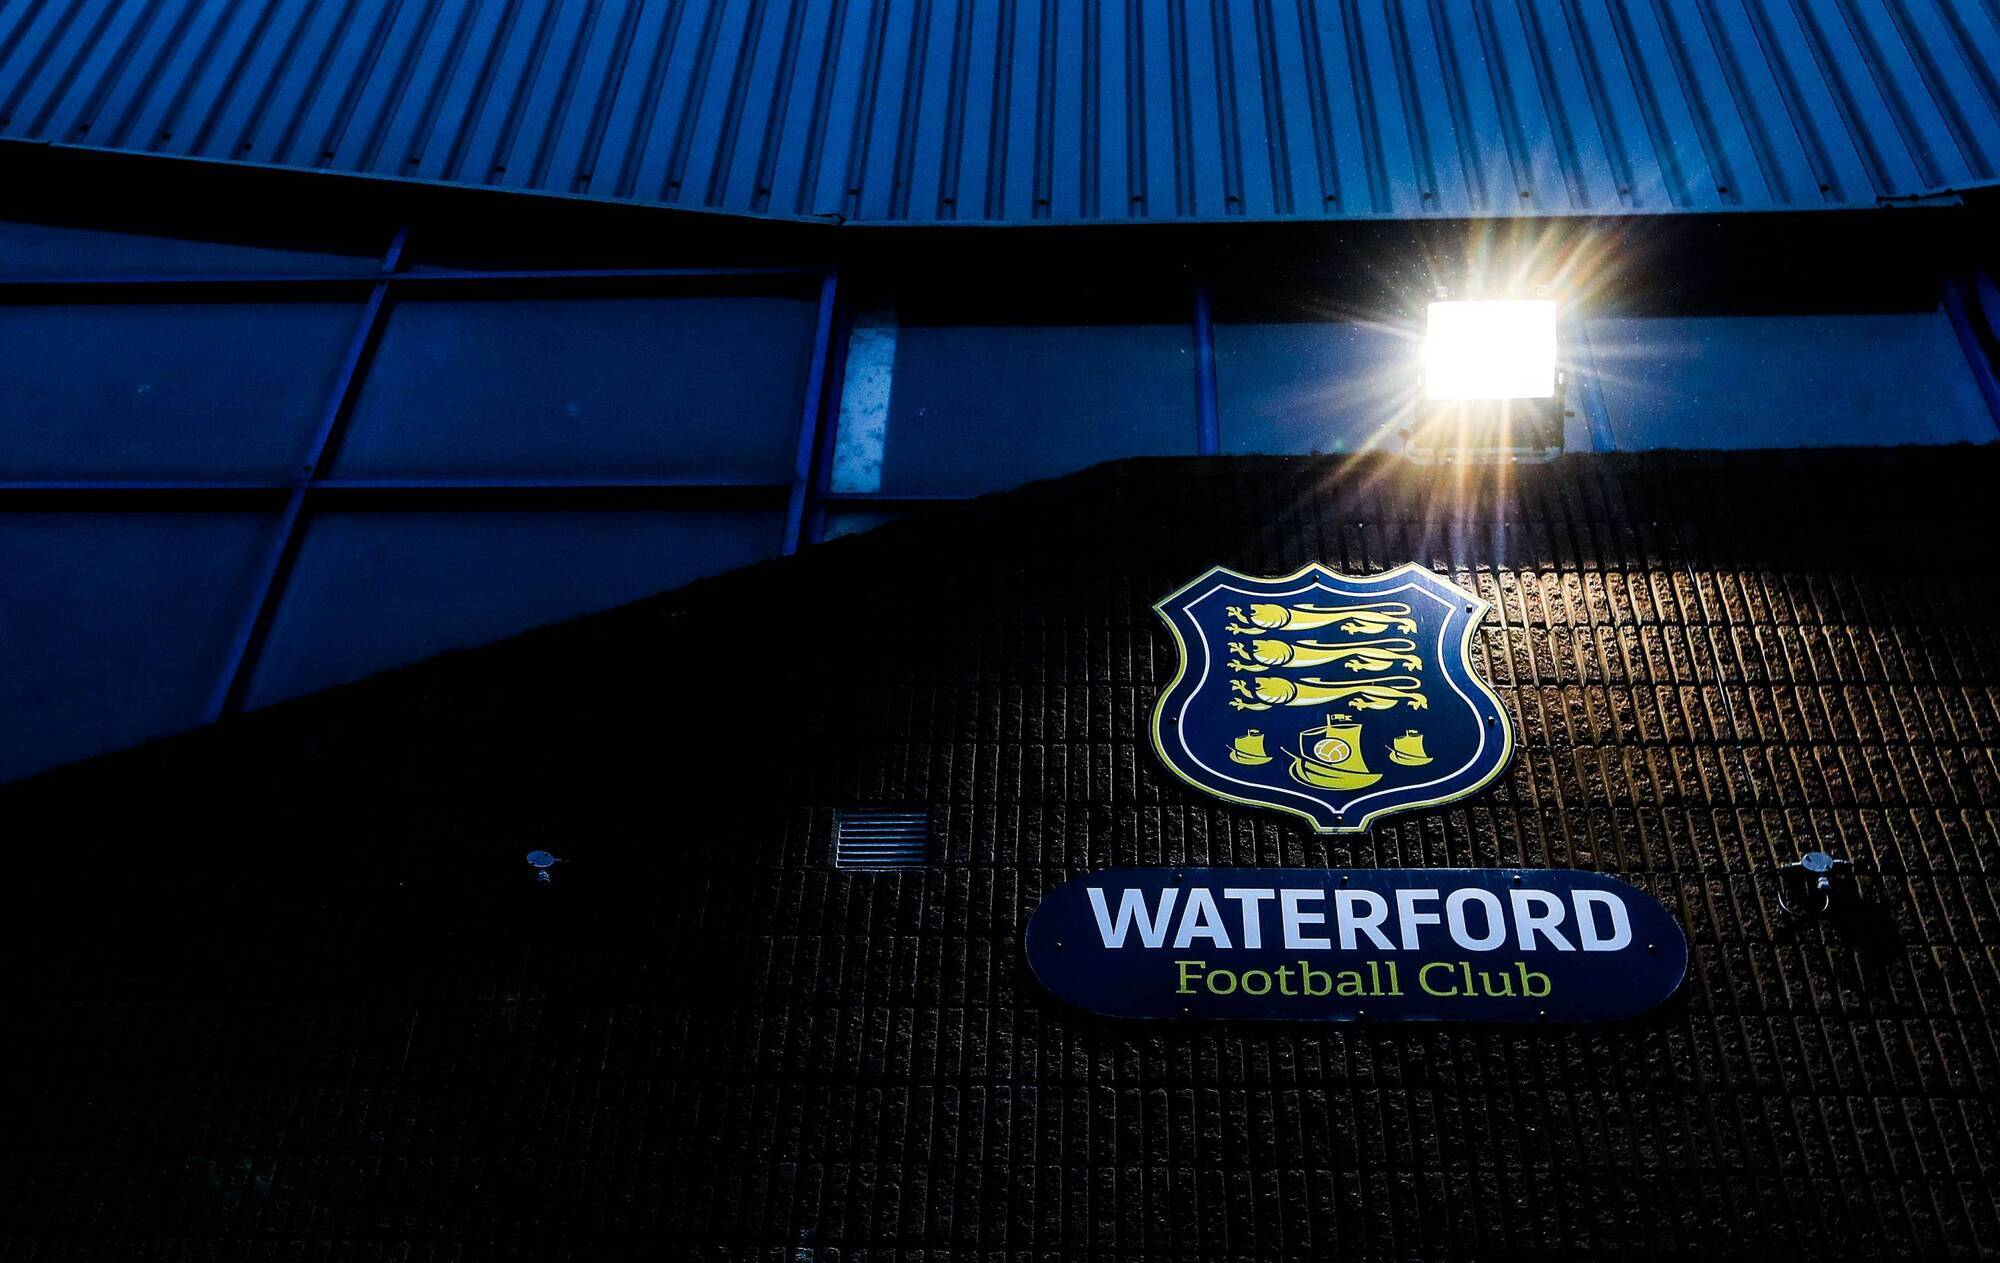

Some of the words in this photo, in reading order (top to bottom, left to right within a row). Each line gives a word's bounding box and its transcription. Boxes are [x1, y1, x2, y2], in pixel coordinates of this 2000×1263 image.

[1086, 887, 1633, 952] WATERFORD
[1175, 960, 1403, 996] Football
[1418, 961, 1552, 998] Club
